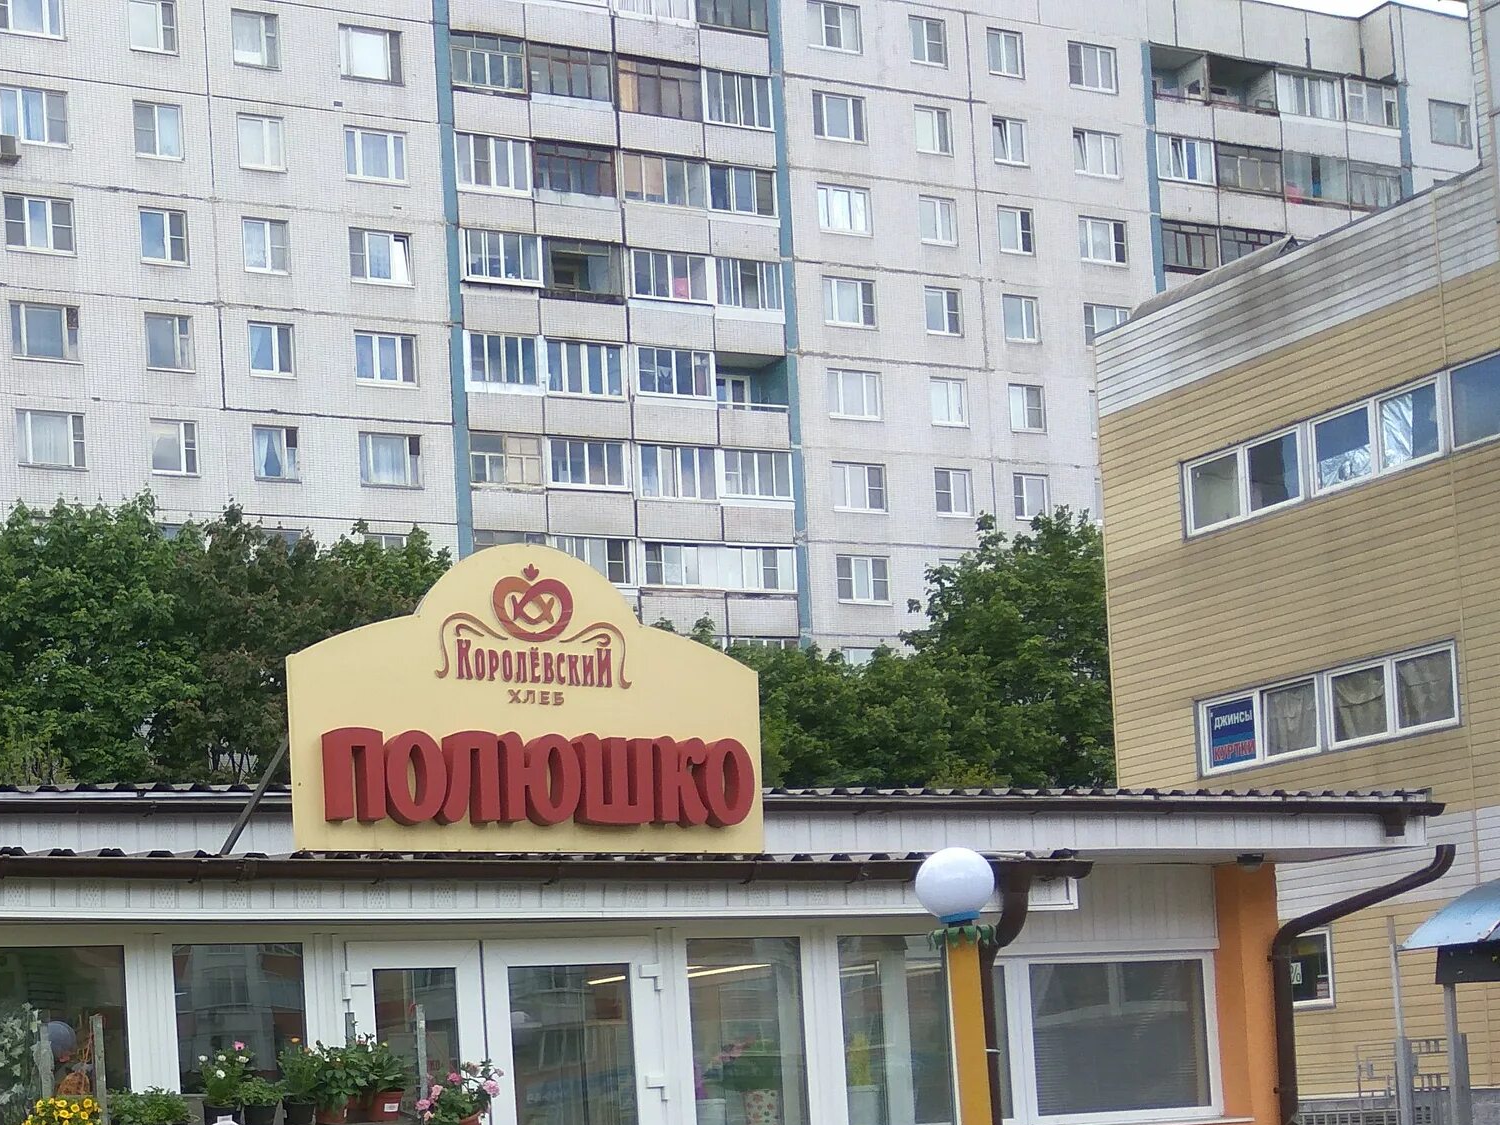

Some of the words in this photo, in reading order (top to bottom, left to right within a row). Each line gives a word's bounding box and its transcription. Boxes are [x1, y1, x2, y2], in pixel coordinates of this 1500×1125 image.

[508, 689, 565, 706] ХЛЕБ
[1214, 709, 1253, 730] ДЖИНСЫ
[1213, 739, 1256, 762] КУРТКИ
[320, 726, 756, 828] ПОЛЮШКО
